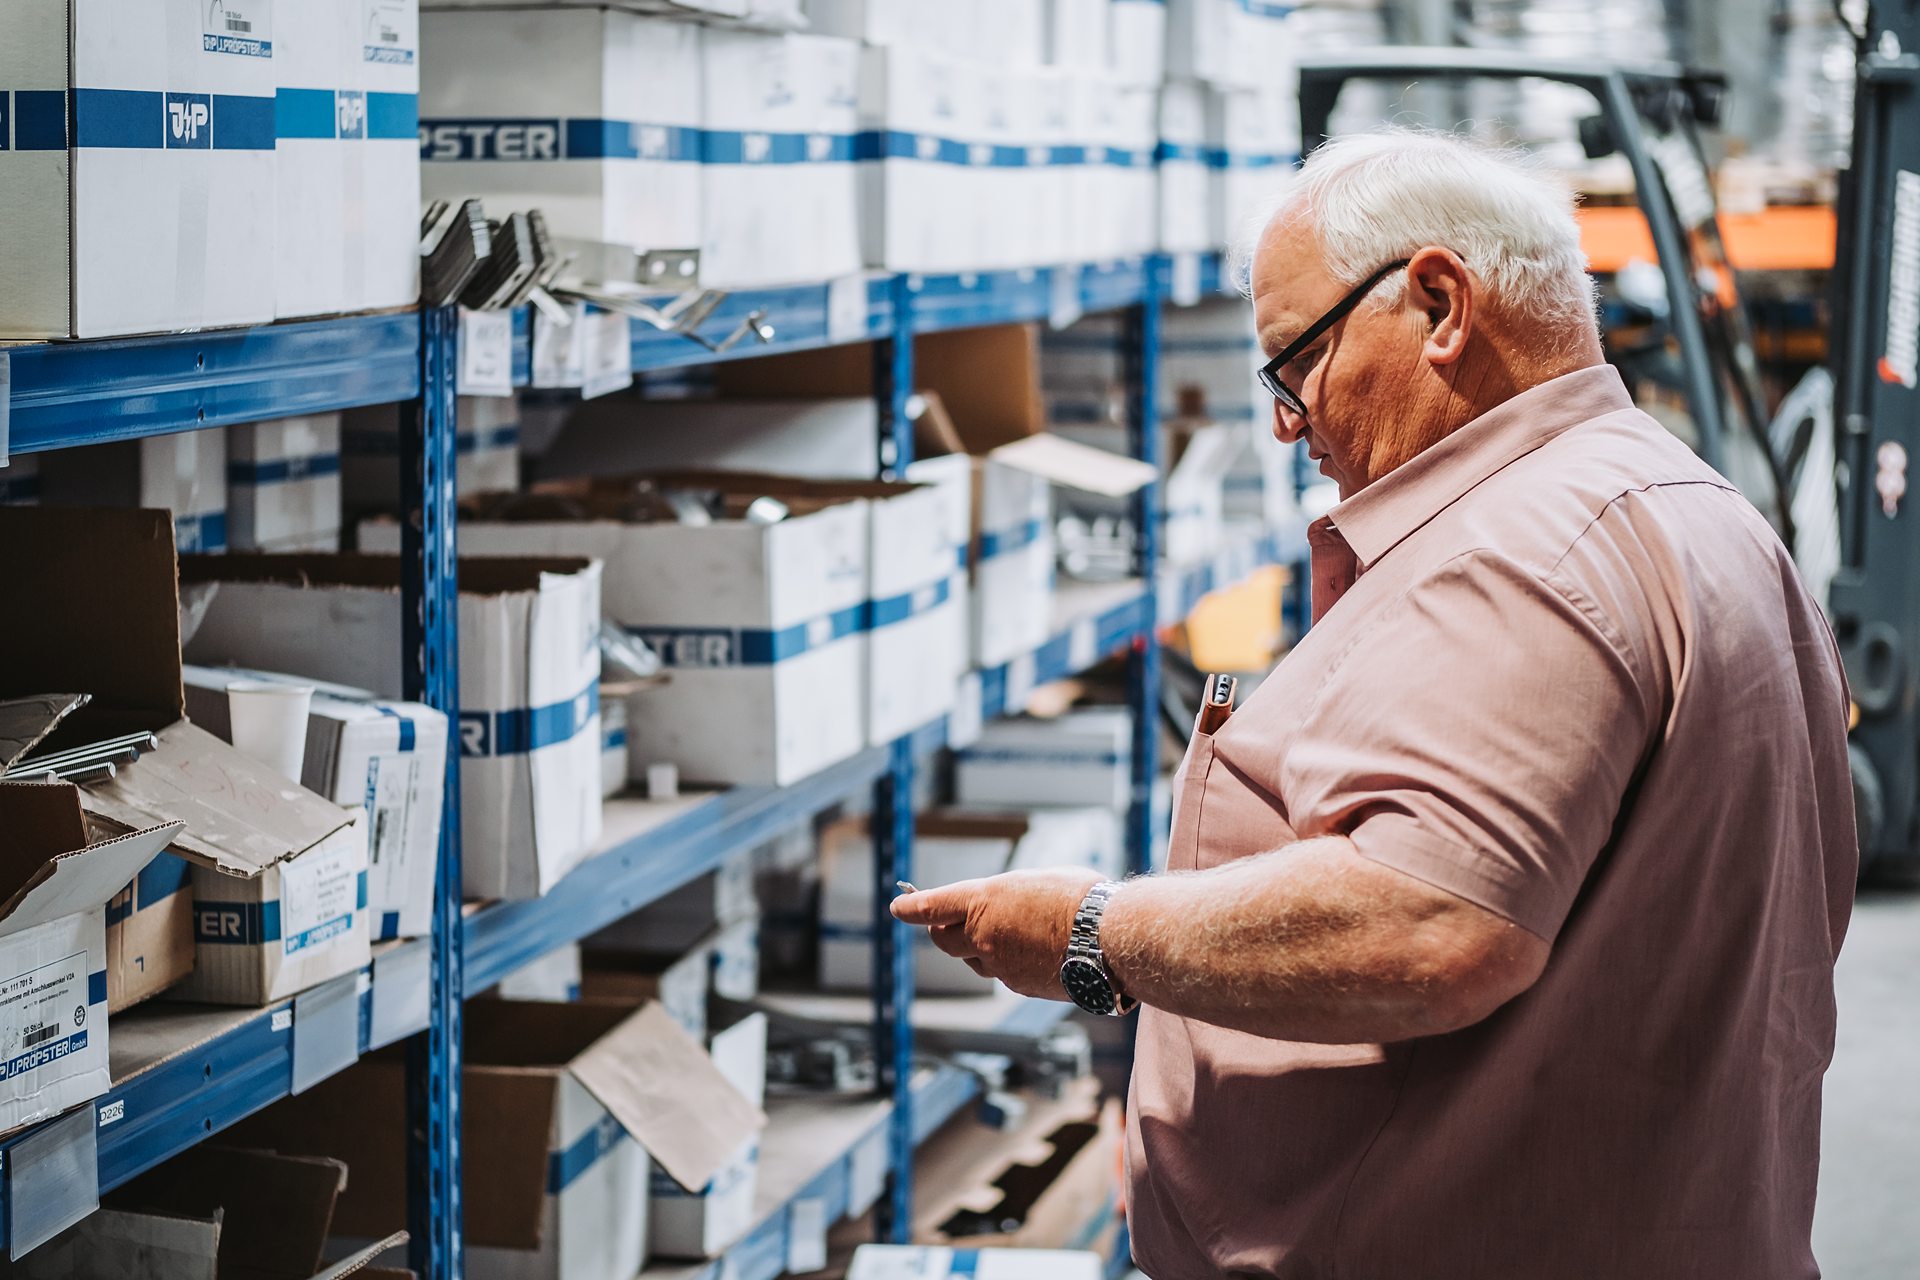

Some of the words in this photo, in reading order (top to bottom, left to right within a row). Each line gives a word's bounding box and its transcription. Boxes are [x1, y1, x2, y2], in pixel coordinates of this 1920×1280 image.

[28, 976, 33, 985] S
[23, 1027, 29, 1036] 50
[9, 1040, 69, 1077] J.PRÖPSTER
[71, 1037, 87, 1052] GmbH
[100, 1104, 124, 1122] D226
